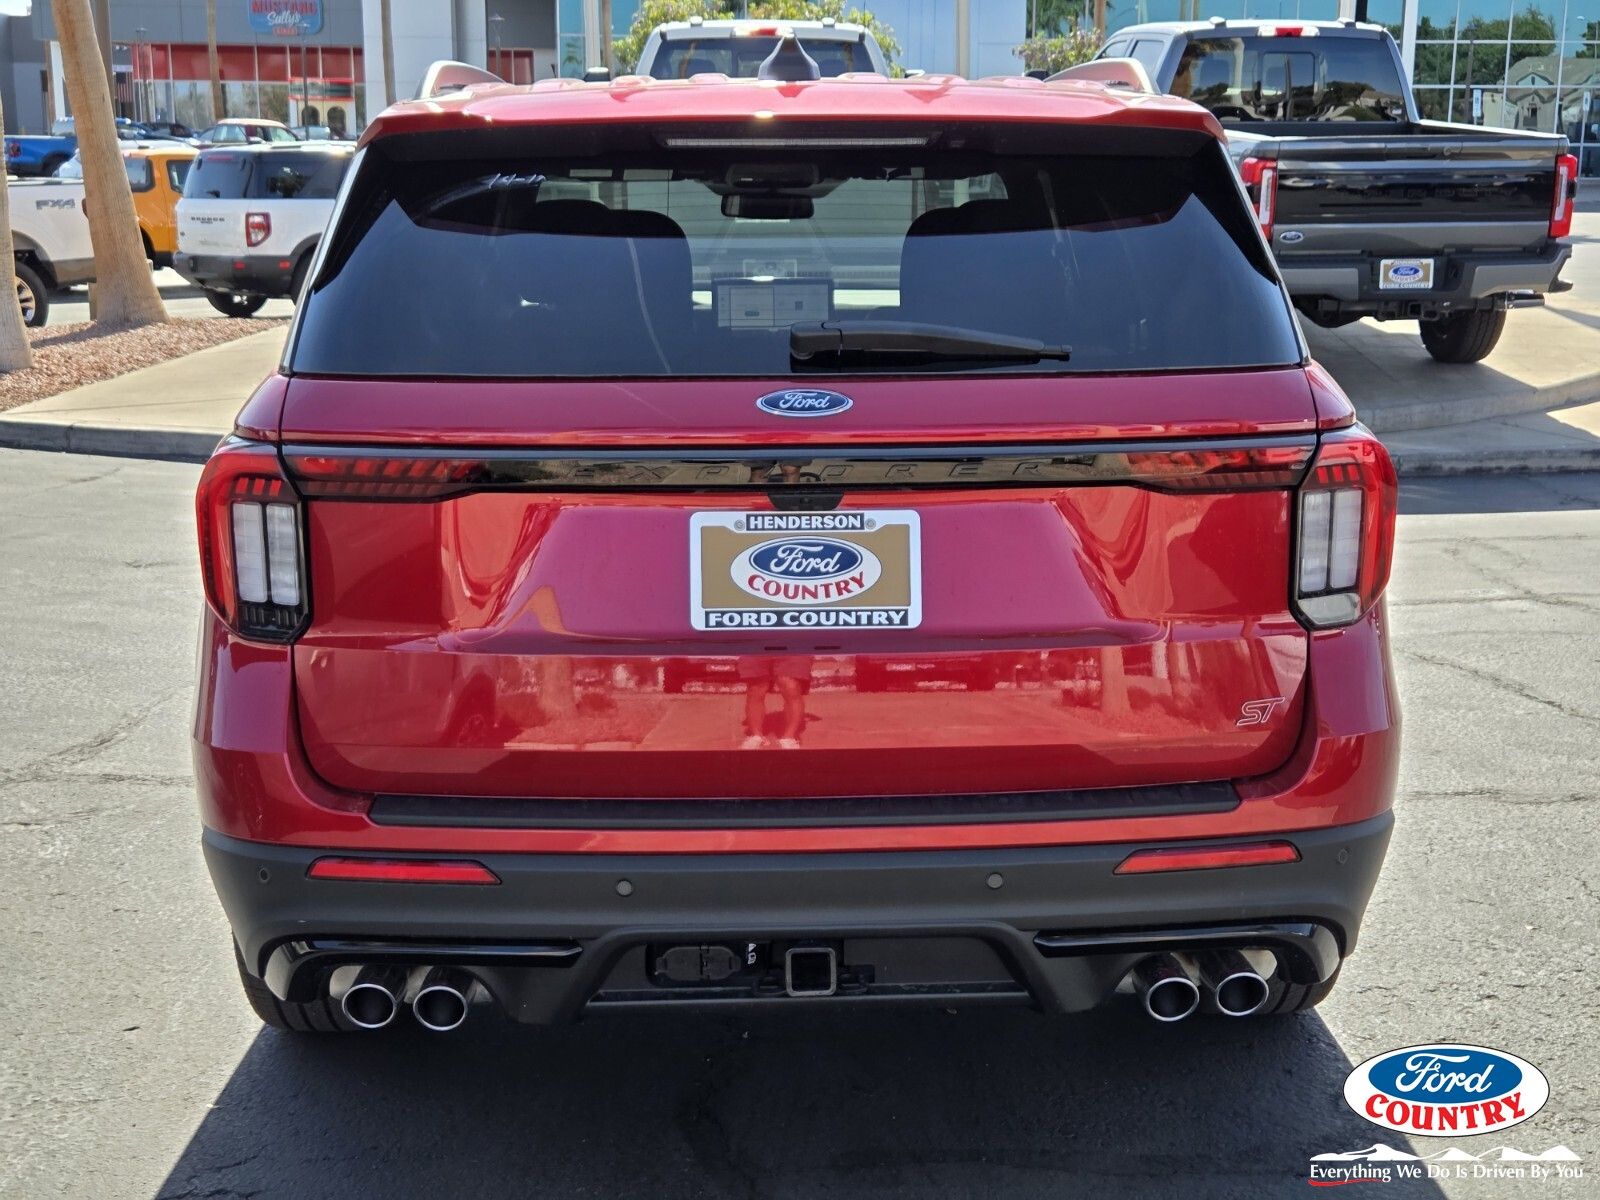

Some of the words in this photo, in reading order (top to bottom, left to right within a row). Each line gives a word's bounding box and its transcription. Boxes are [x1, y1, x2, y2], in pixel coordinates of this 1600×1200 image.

[779, 392, 831, 409] Ford
[750, 515, 862, 530] HENDERSON
[770, 544, 842, 573] Ford
[747, 571, 865, 601] COUNTRY
[708, 612, 778, 627] FORD
[782, 610, 906, 627] COUNTRY
[1236, 696, 1285, 726] ST
